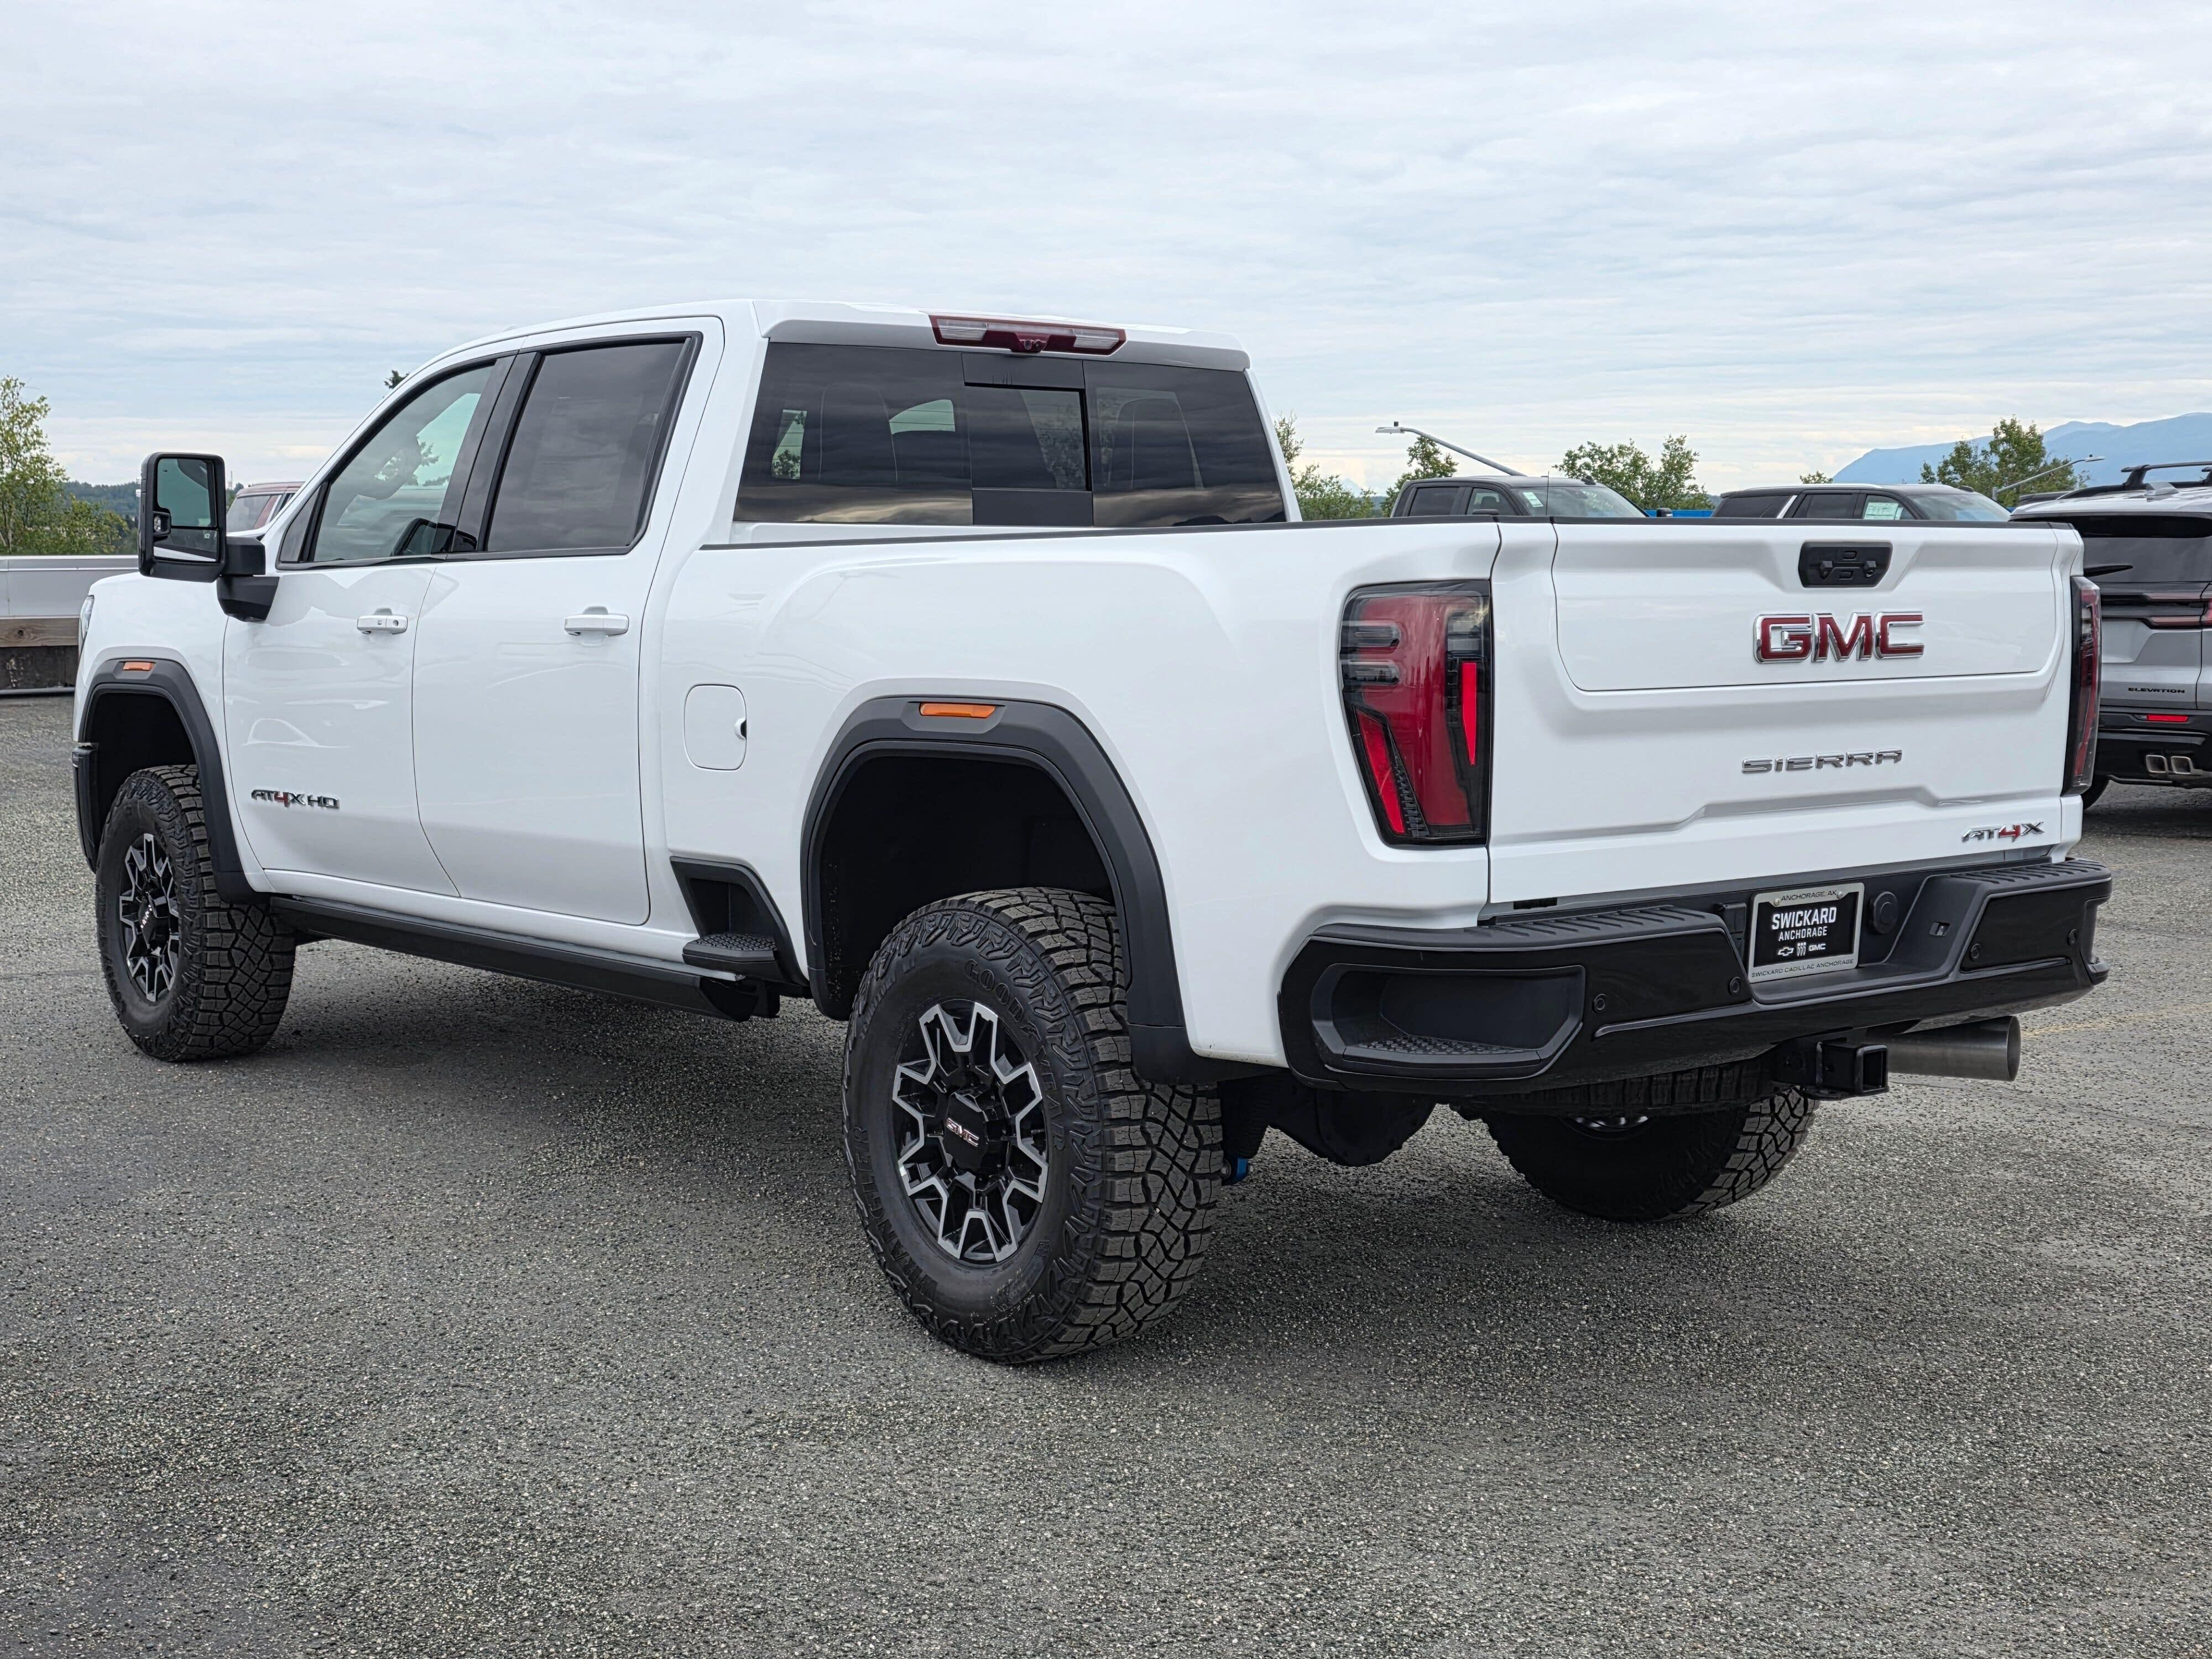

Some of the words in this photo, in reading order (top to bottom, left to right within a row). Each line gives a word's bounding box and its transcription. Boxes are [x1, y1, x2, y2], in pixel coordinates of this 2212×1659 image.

[1754, 611, 1924, 663] GMC
[1742, 748, 1902, 774] SIERRA
[1961, 821, 2044, 843] AT4X
[1771, 907, 1837, 930] SWICKARD
[1778, 926, 1828, 941] ANCHORAGE
[1808, 943, 1826, 952] GMC
[1751, 968, 1783, 978] SWICKARD
[1785, 964, 1814, 973] CADILLAC
[1817, 959, 1854, 968] ANCHORAGE
[964, 958, 1066, 1151] GOODYEAR
[946, 1118, 979, 1147] GMC
